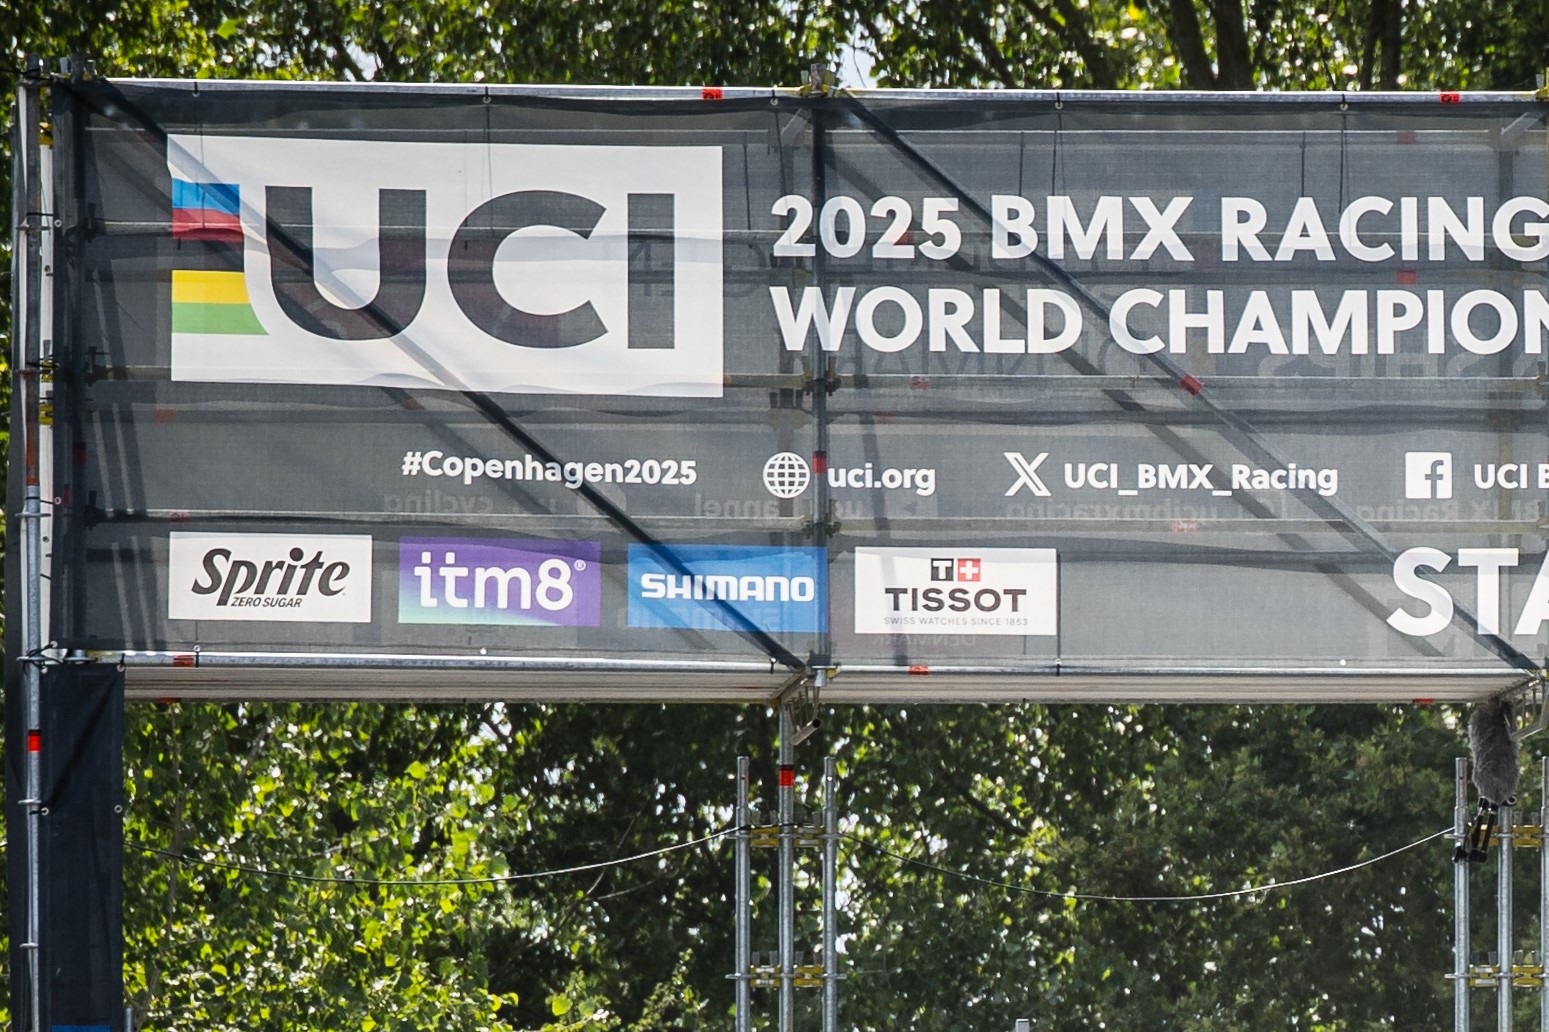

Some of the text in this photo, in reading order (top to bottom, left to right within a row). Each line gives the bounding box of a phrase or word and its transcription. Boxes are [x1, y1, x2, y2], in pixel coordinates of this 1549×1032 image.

[772, 195, 961, 259] 2025
[992, 196, 1193, 261] BMX
[264, 186, 676, 349] UCI
[770, 286, 1083, 353] WORLD
[402, 450, 697, 490] #Copenhagen2025
[828, 463, 936, 496] uci.org
[1064, 461, 1338, 498] UCI_BMX_Racing
[1474, 463, 1529, 490] UCI
[191, 547, 351, 606] Sprite
[641, 573, 815, 601] SHIMANO
[231, 597, 303, 608] ZERO SUGAR
[884, 588, 1026, 612] TISSOT
[884, 617, 916, 625] SWISS
[920, 617, 967, 626] WATCHES
[970, 618, 1001, 626] SINCE
